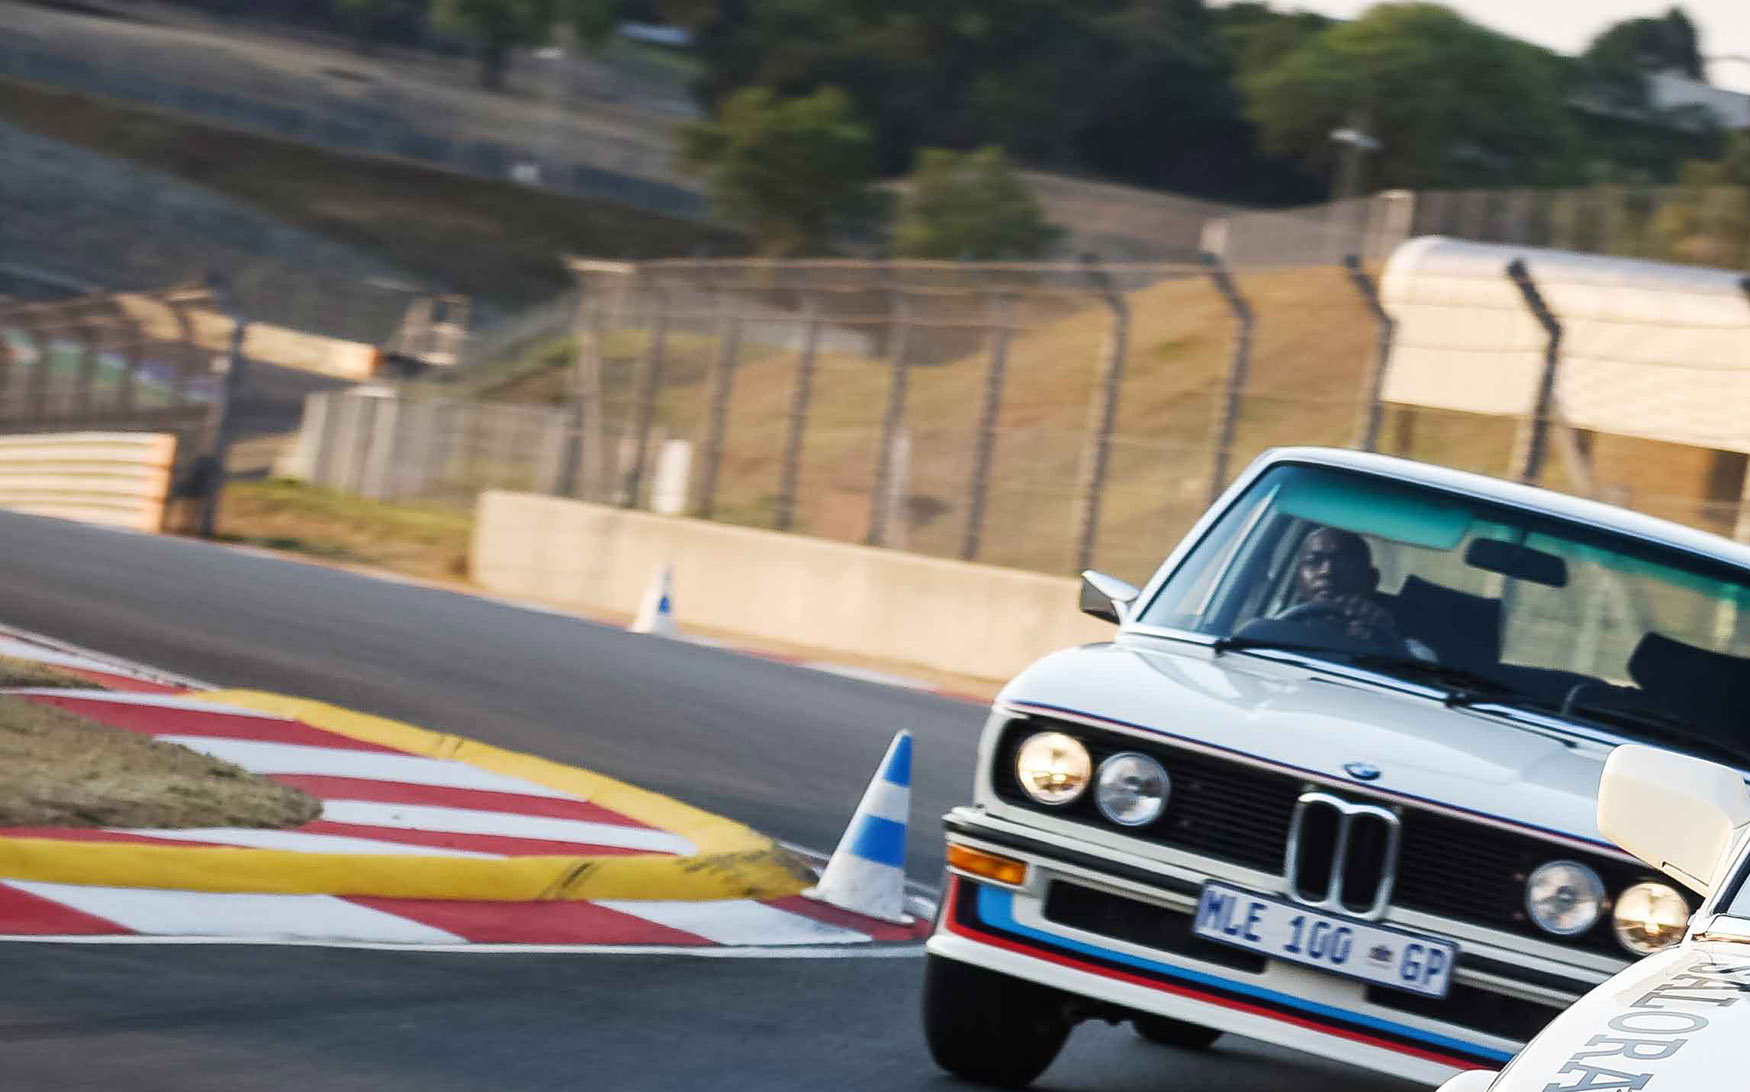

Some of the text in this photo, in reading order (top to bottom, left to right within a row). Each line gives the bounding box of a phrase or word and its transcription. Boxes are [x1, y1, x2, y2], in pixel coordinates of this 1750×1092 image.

[1198, 889, 1447, 986] MLE 100 GP
